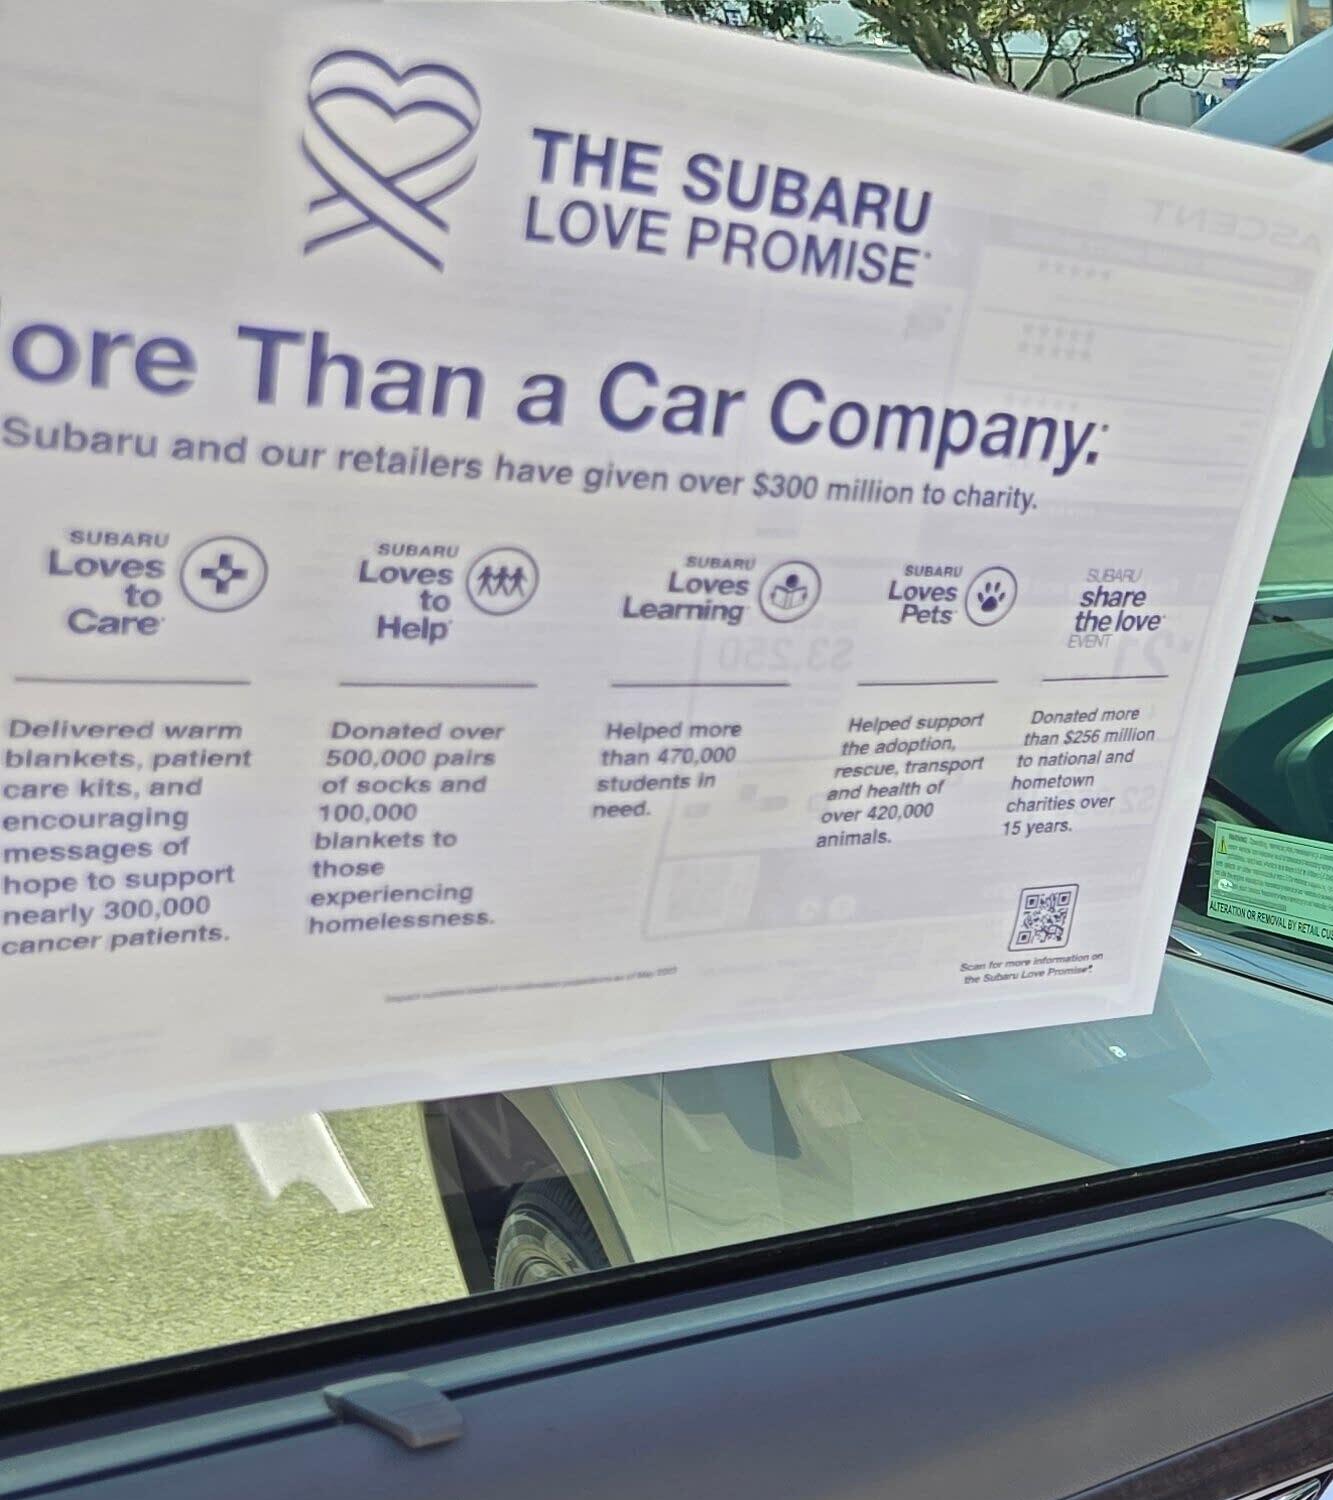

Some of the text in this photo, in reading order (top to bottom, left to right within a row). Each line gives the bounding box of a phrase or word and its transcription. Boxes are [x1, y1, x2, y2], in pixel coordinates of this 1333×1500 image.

[532, 128, 933, 237] THE SUBARU
[524, 197, 919, 288] LOVE PROMISE
[12, 323, 1102, 478] ore Than a Car Company.
[2, 416, 1038, 516] Subaru and our retailers have given over $300 million to charity.
[70, 530, 170, 548] SUBARU
[378, 543, 459, 558] SUBARU
[48, 549, 165, 579] Loves
[359, 559, 454, 585] Loves
[686, 556, 756, 570] SUBARU
[904, 564, 963, 578] SUBARU
[668, 571, 749, 596] Loves
[1086, 568, 1143, 583] SUBARU
[124, 584, 162, 608] to
[420, 589, 450, 612] to
[888, 580, 958, 602] Loves
[1080, 585, 1147, 608] share
[623, 595, 744, 626] Learning
[900, 604, 952, 625] Pets
[1075, 610, 1162, 632] the love
[68, 608, 161, 636] Care
[377, 615, 449, 645] Help
[1067, 634, 1113, 649] EVENT
[848, 713, 985, 735] Helped support
[1031, 708, 1140, 725] Donated more
[9, 719, 243, 740] Delivered warm
[331, 721, 505, 741] Donated over
[606, 722, 742, 743] Helped more
[1024, 728, 1155, 746] than $256 million
[602, 746, 737, 767] than 470,000
[841, 737, 957, 756] the adoption,
[5, 749, 253, 772] blankets, patient
[326, 749, 495, 771] 500,000 pairs
[834, 756, 985, 778] rescue, transport
[1017, 749, 1135, 768] to national and
[3, 776, 203, 800] care kits, and
[322, 776, 487, 795] of socks and
[597, 772, 716, 792] students in
[827, 779, 946, 801] and health of
[1011, 775, 1094, 790] hometown
[319, 803, 418, 824] 100,000
[592, 800, 651, 818] need.
[821, 802, 934, 824] over 420,000
[1007, 796, 1075, 813] charities
[1081, 796, 1116, 809] over
[2, 807, 189, 833] encouraging
[1003, 821, 1072, 838] 15 years.
[314, 831, 458, 850] blankets to
[816, 829, 892, 848] animals.
[3, 836, 191, 864] messages of
[313, 860, 385, 879] those
[4, 864, 235, 898] hope to support
[310, 883, 473, 909] experiencing
[3, 895, 211, 928] nearly 300,000
[1210, 900, 1246, 918] ALTERATION
[1247, 910, 1256, 920] OR
[1257, 911, 1287, 930] REMOVAL
[1288, 920, 1297, 931] BY
[1298, 922, 1320, 937] RETAIL
[309, 911, 495, 935] homelessness.
[1, 924, 230, 956] cancer patients.
[960, 953, 1103, 972] Scan for more information on
[964, 975, 980, 985] the
[984, 971, 1019, 983] Subaru
[1022, 969, 1045, 980] Love
